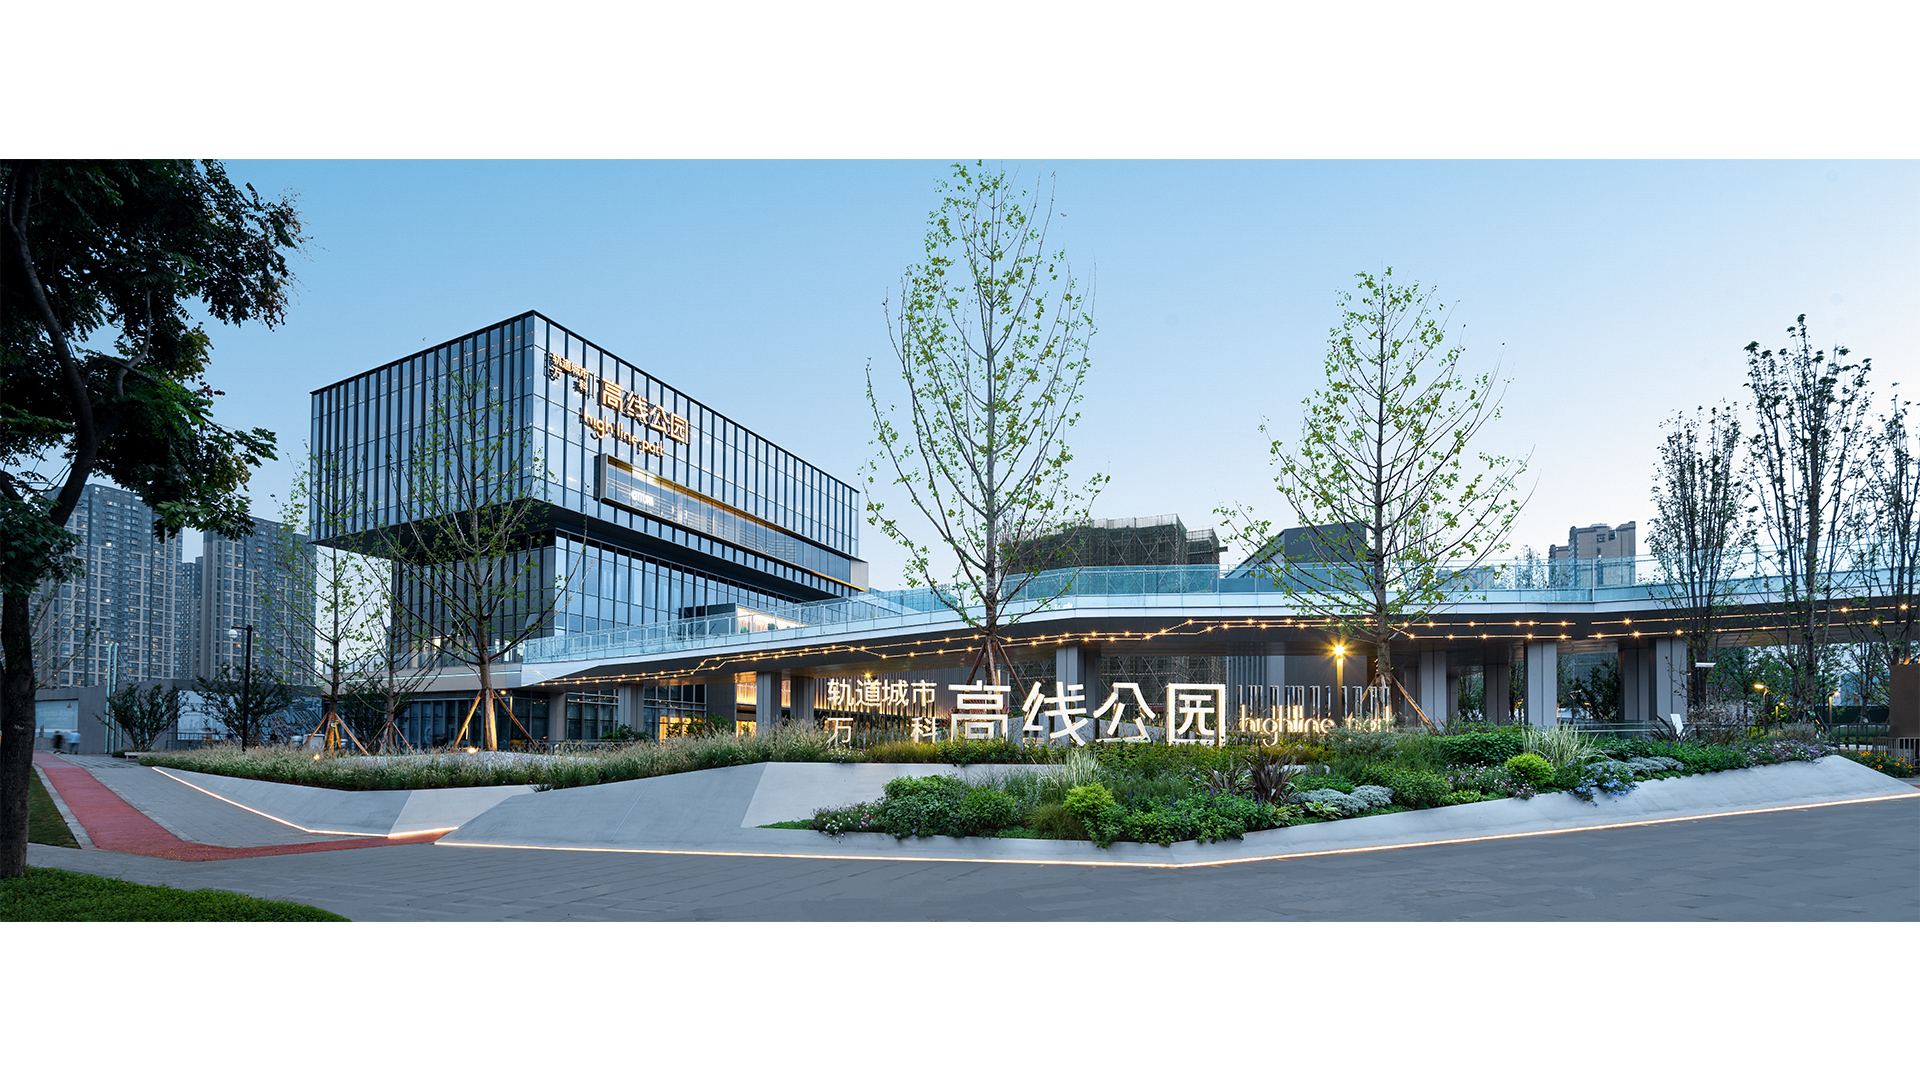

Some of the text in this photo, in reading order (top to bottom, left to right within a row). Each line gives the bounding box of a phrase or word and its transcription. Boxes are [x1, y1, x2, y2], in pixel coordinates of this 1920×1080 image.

[584, 405, 614, 439] high
[617, 421, 639, 445] line
[602, 378, 689, 445] 高线公园
[827, 678, 938, 707] 轨道城市
[948, 680, 1226, 747] 高线公园
